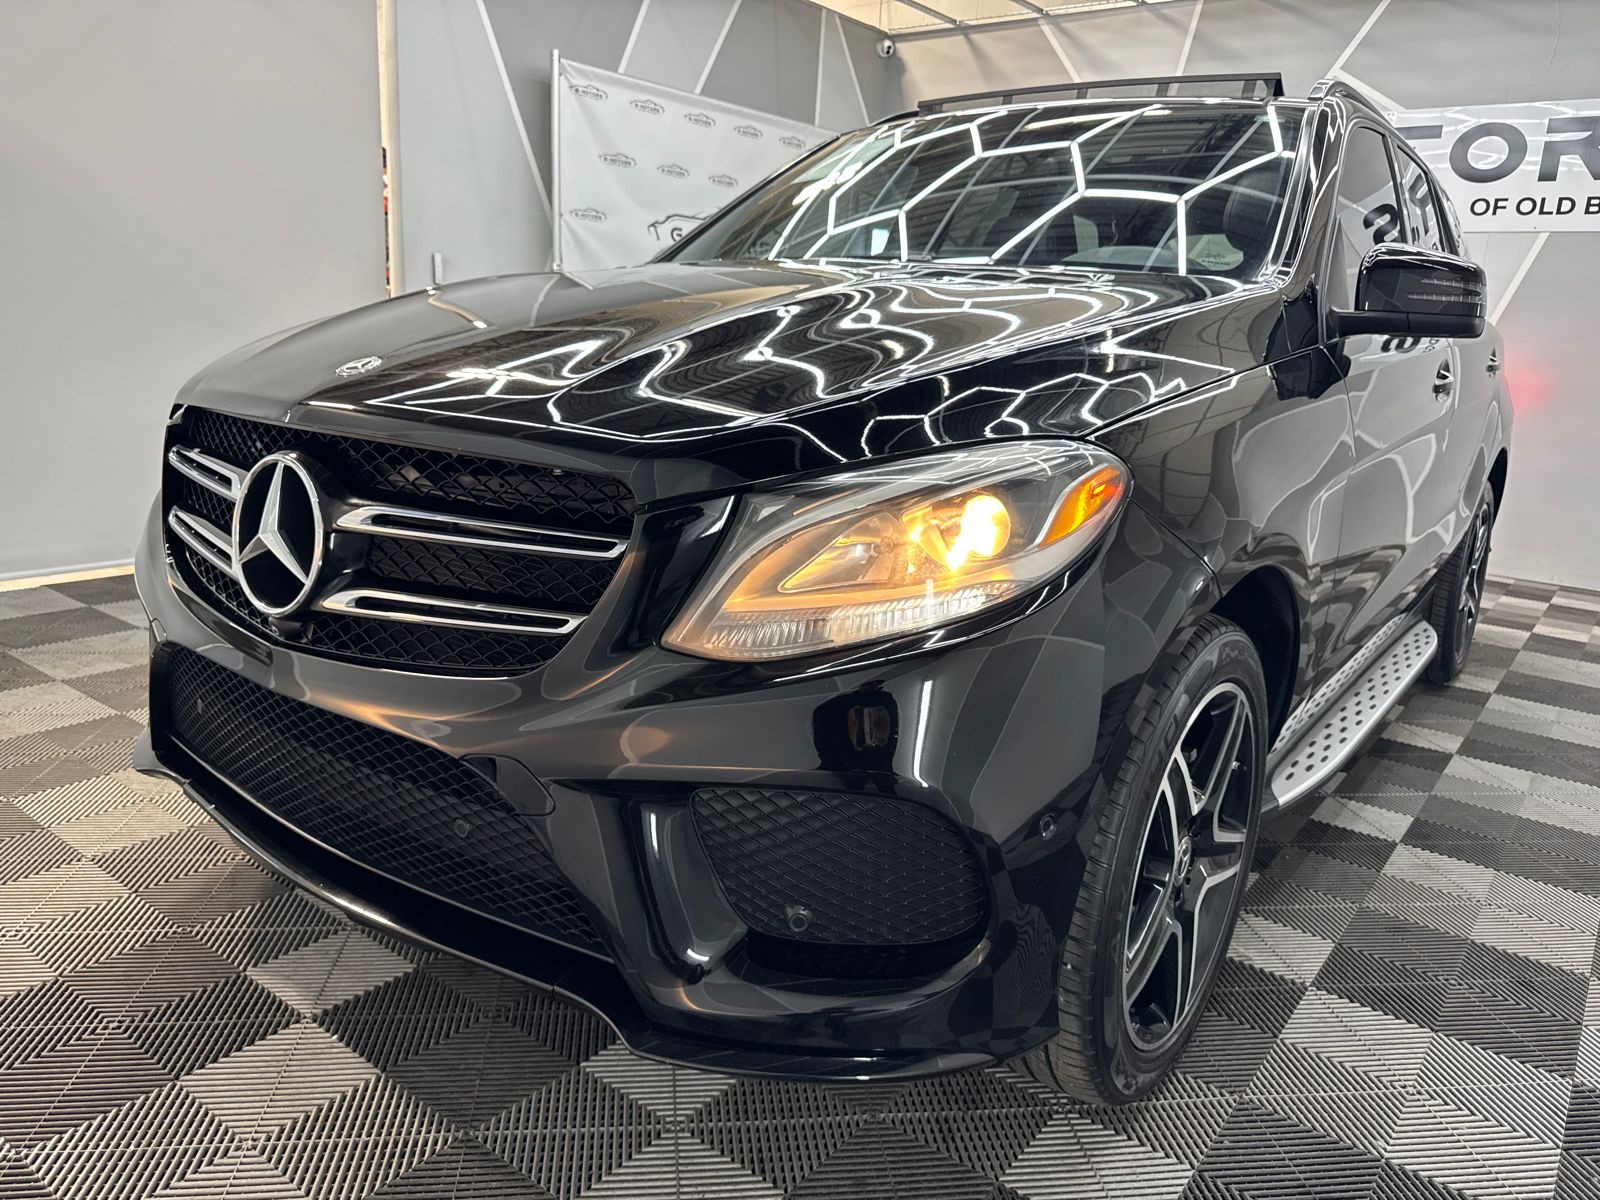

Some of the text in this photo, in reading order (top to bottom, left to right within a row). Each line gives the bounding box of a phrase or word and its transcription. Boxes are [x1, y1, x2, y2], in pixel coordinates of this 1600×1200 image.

[1470, 197, 1509, 216] OF
[1515, 197, 1576, 215] OLD
[671, 228, 682, 242] G
